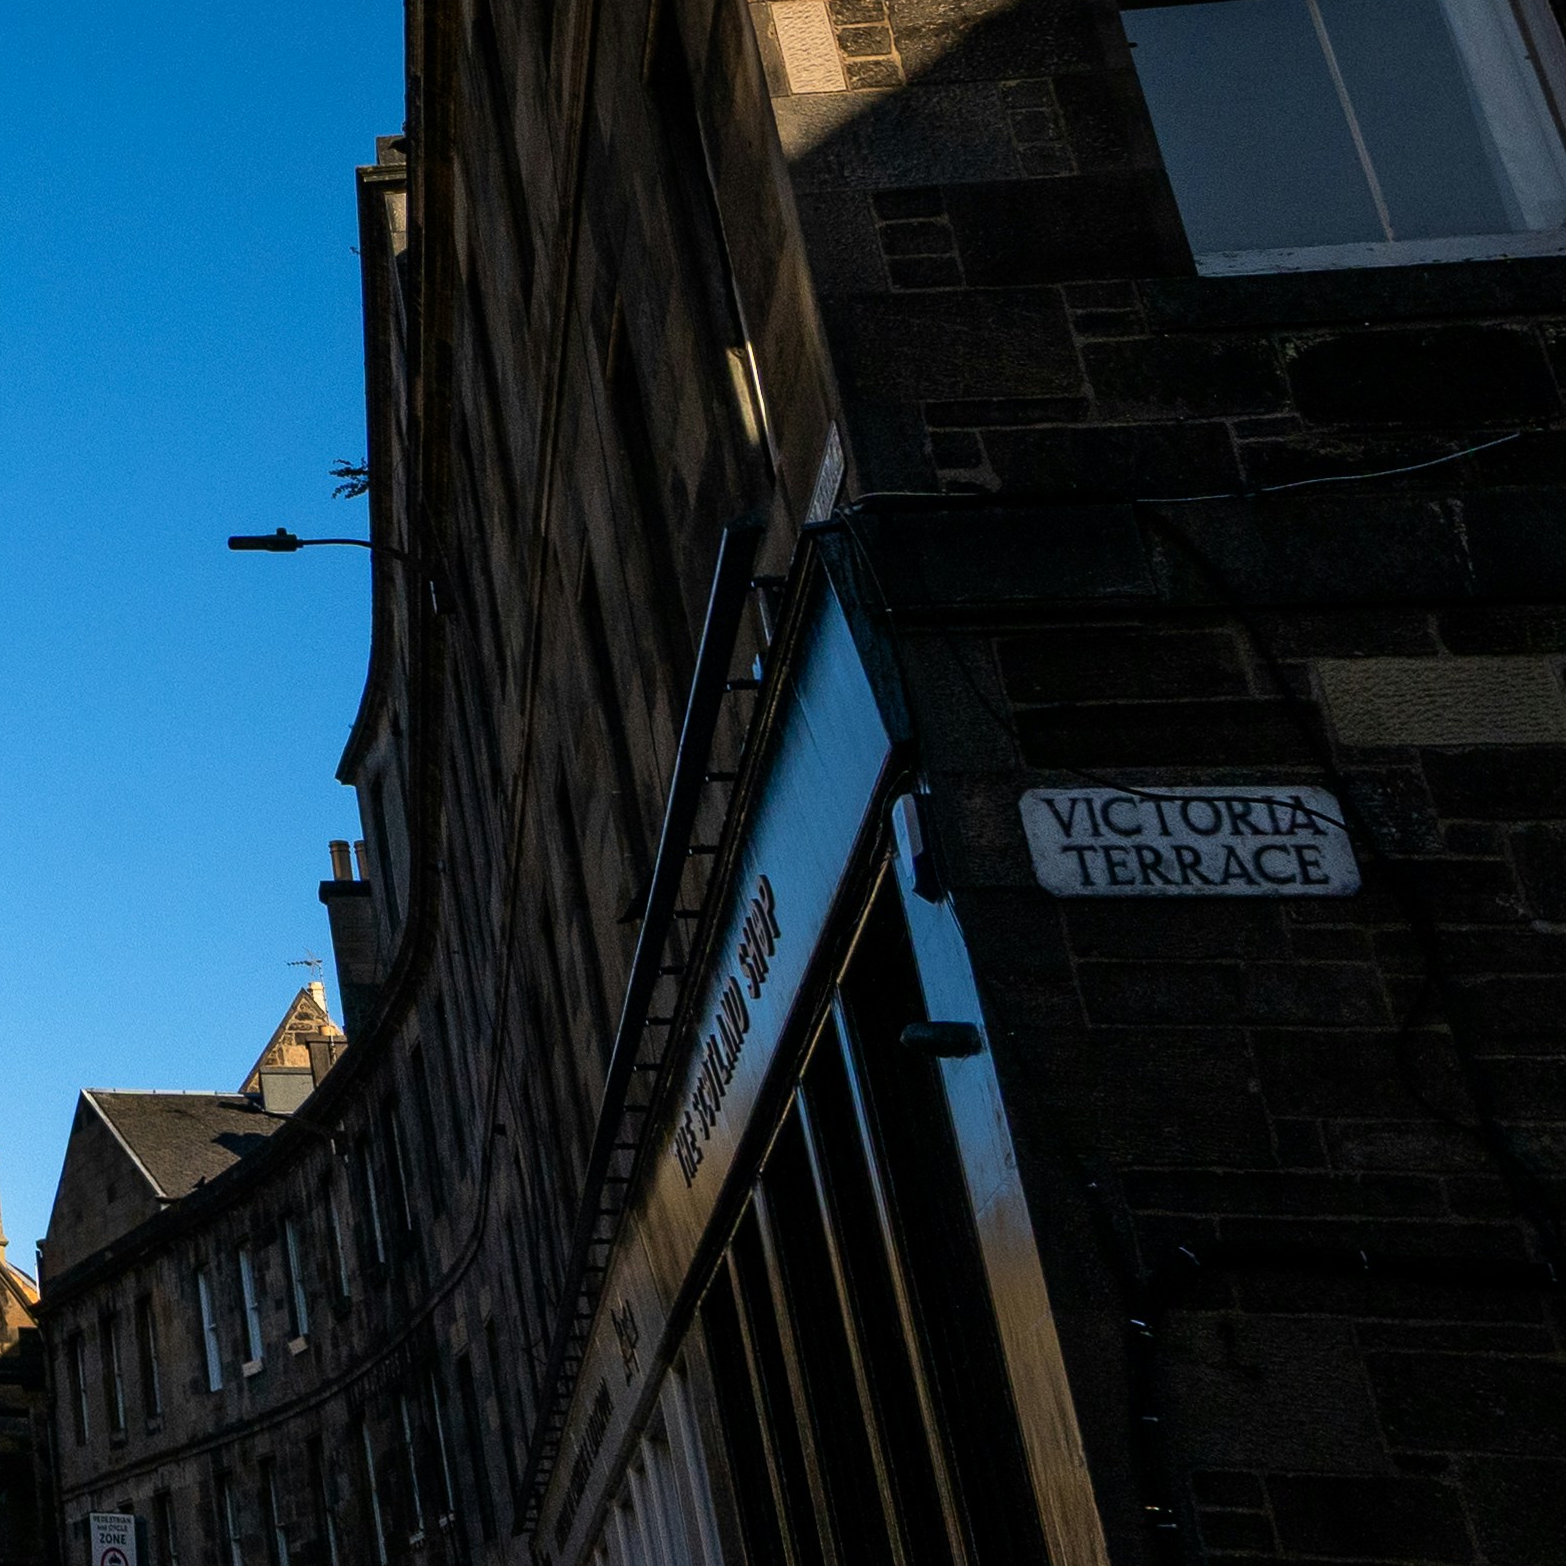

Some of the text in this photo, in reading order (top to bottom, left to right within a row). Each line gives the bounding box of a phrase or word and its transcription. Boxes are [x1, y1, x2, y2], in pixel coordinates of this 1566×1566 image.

[1042, 795, 1329, 837] VICTORIA
[1062, 843, 1330, 887] TERRACE
[674, 874, 781, 1188] THE SCOTLAND SHOP
[99, 1533, 127, 1545] ZONE
